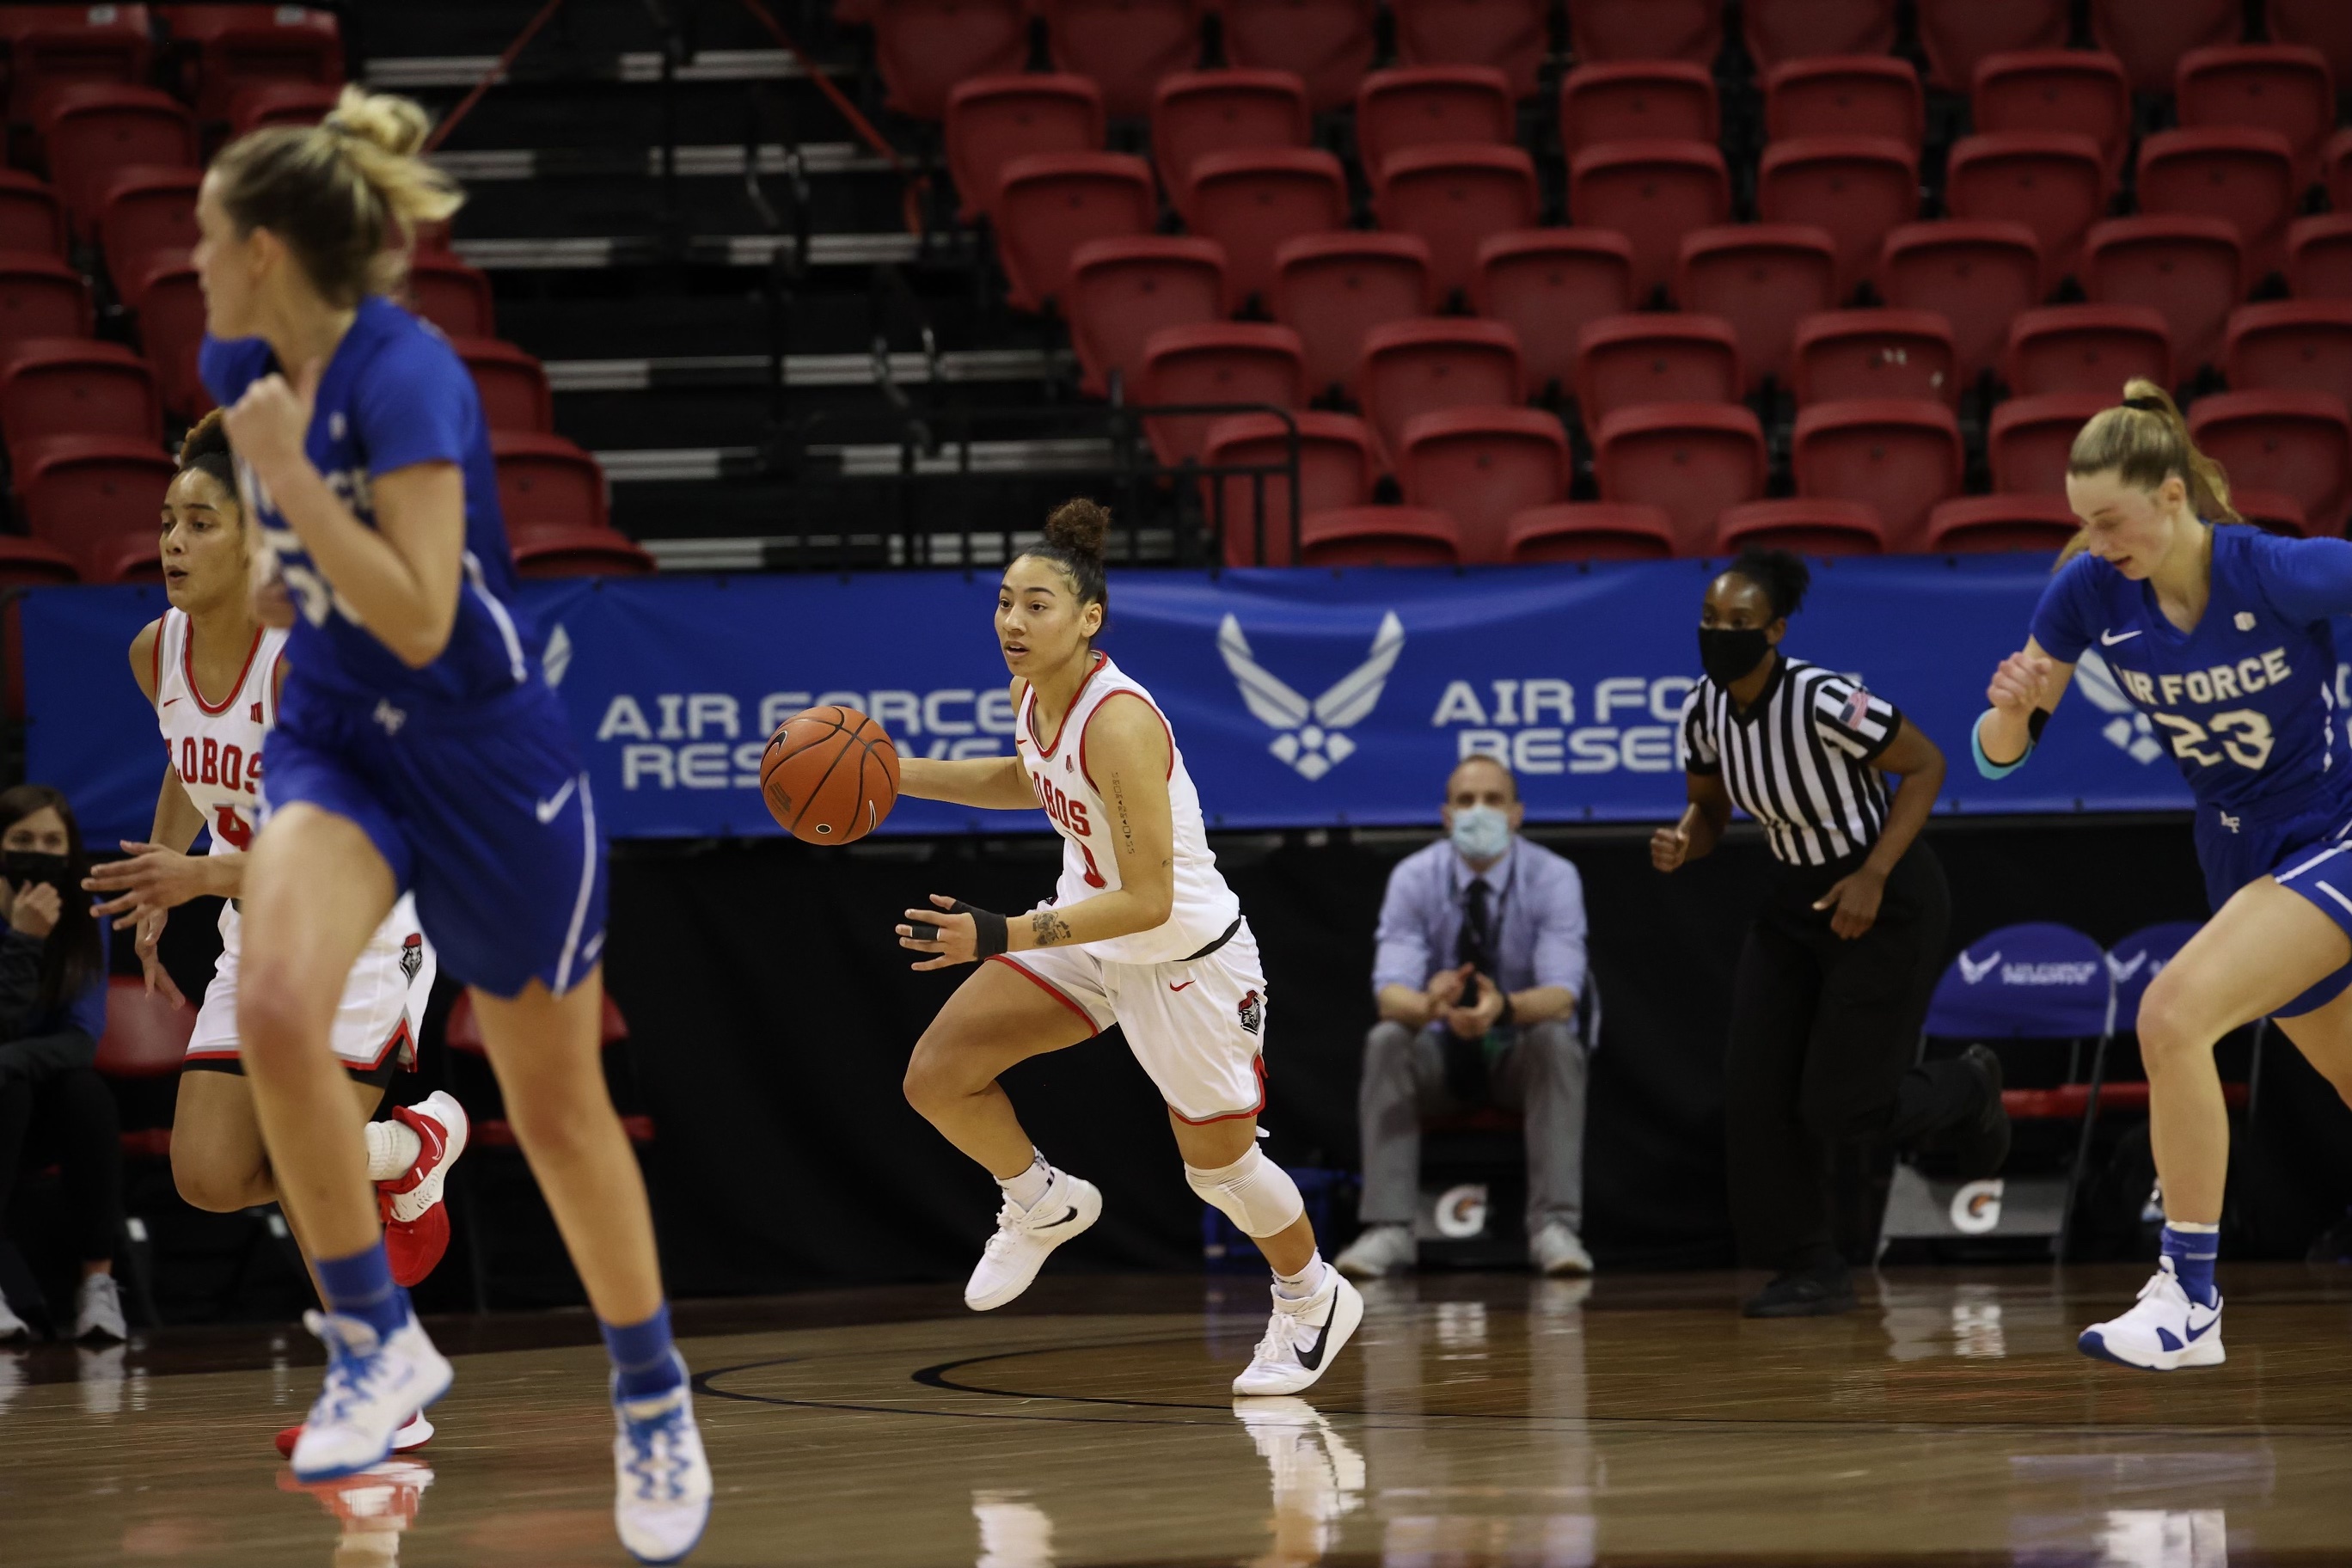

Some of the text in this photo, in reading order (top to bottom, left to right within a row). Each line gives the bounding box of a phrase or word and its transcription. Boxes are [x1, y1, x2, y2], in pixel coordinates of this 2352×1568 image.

[1431, 678, 1575, 728] AIR
[2159, 646, 2293, 705] FORCE
[597, 693, 739, 742] AIR
[2153, 707, 2275, 770] 23
[1458, 726, 1686, 775] RESE
[212, 803, 254, 852] 4
[1032, 770, 1092, 837] OBOS
[1436, 1183, 1487, 1239] G
[1950, 1179, 2005, 1234] G
